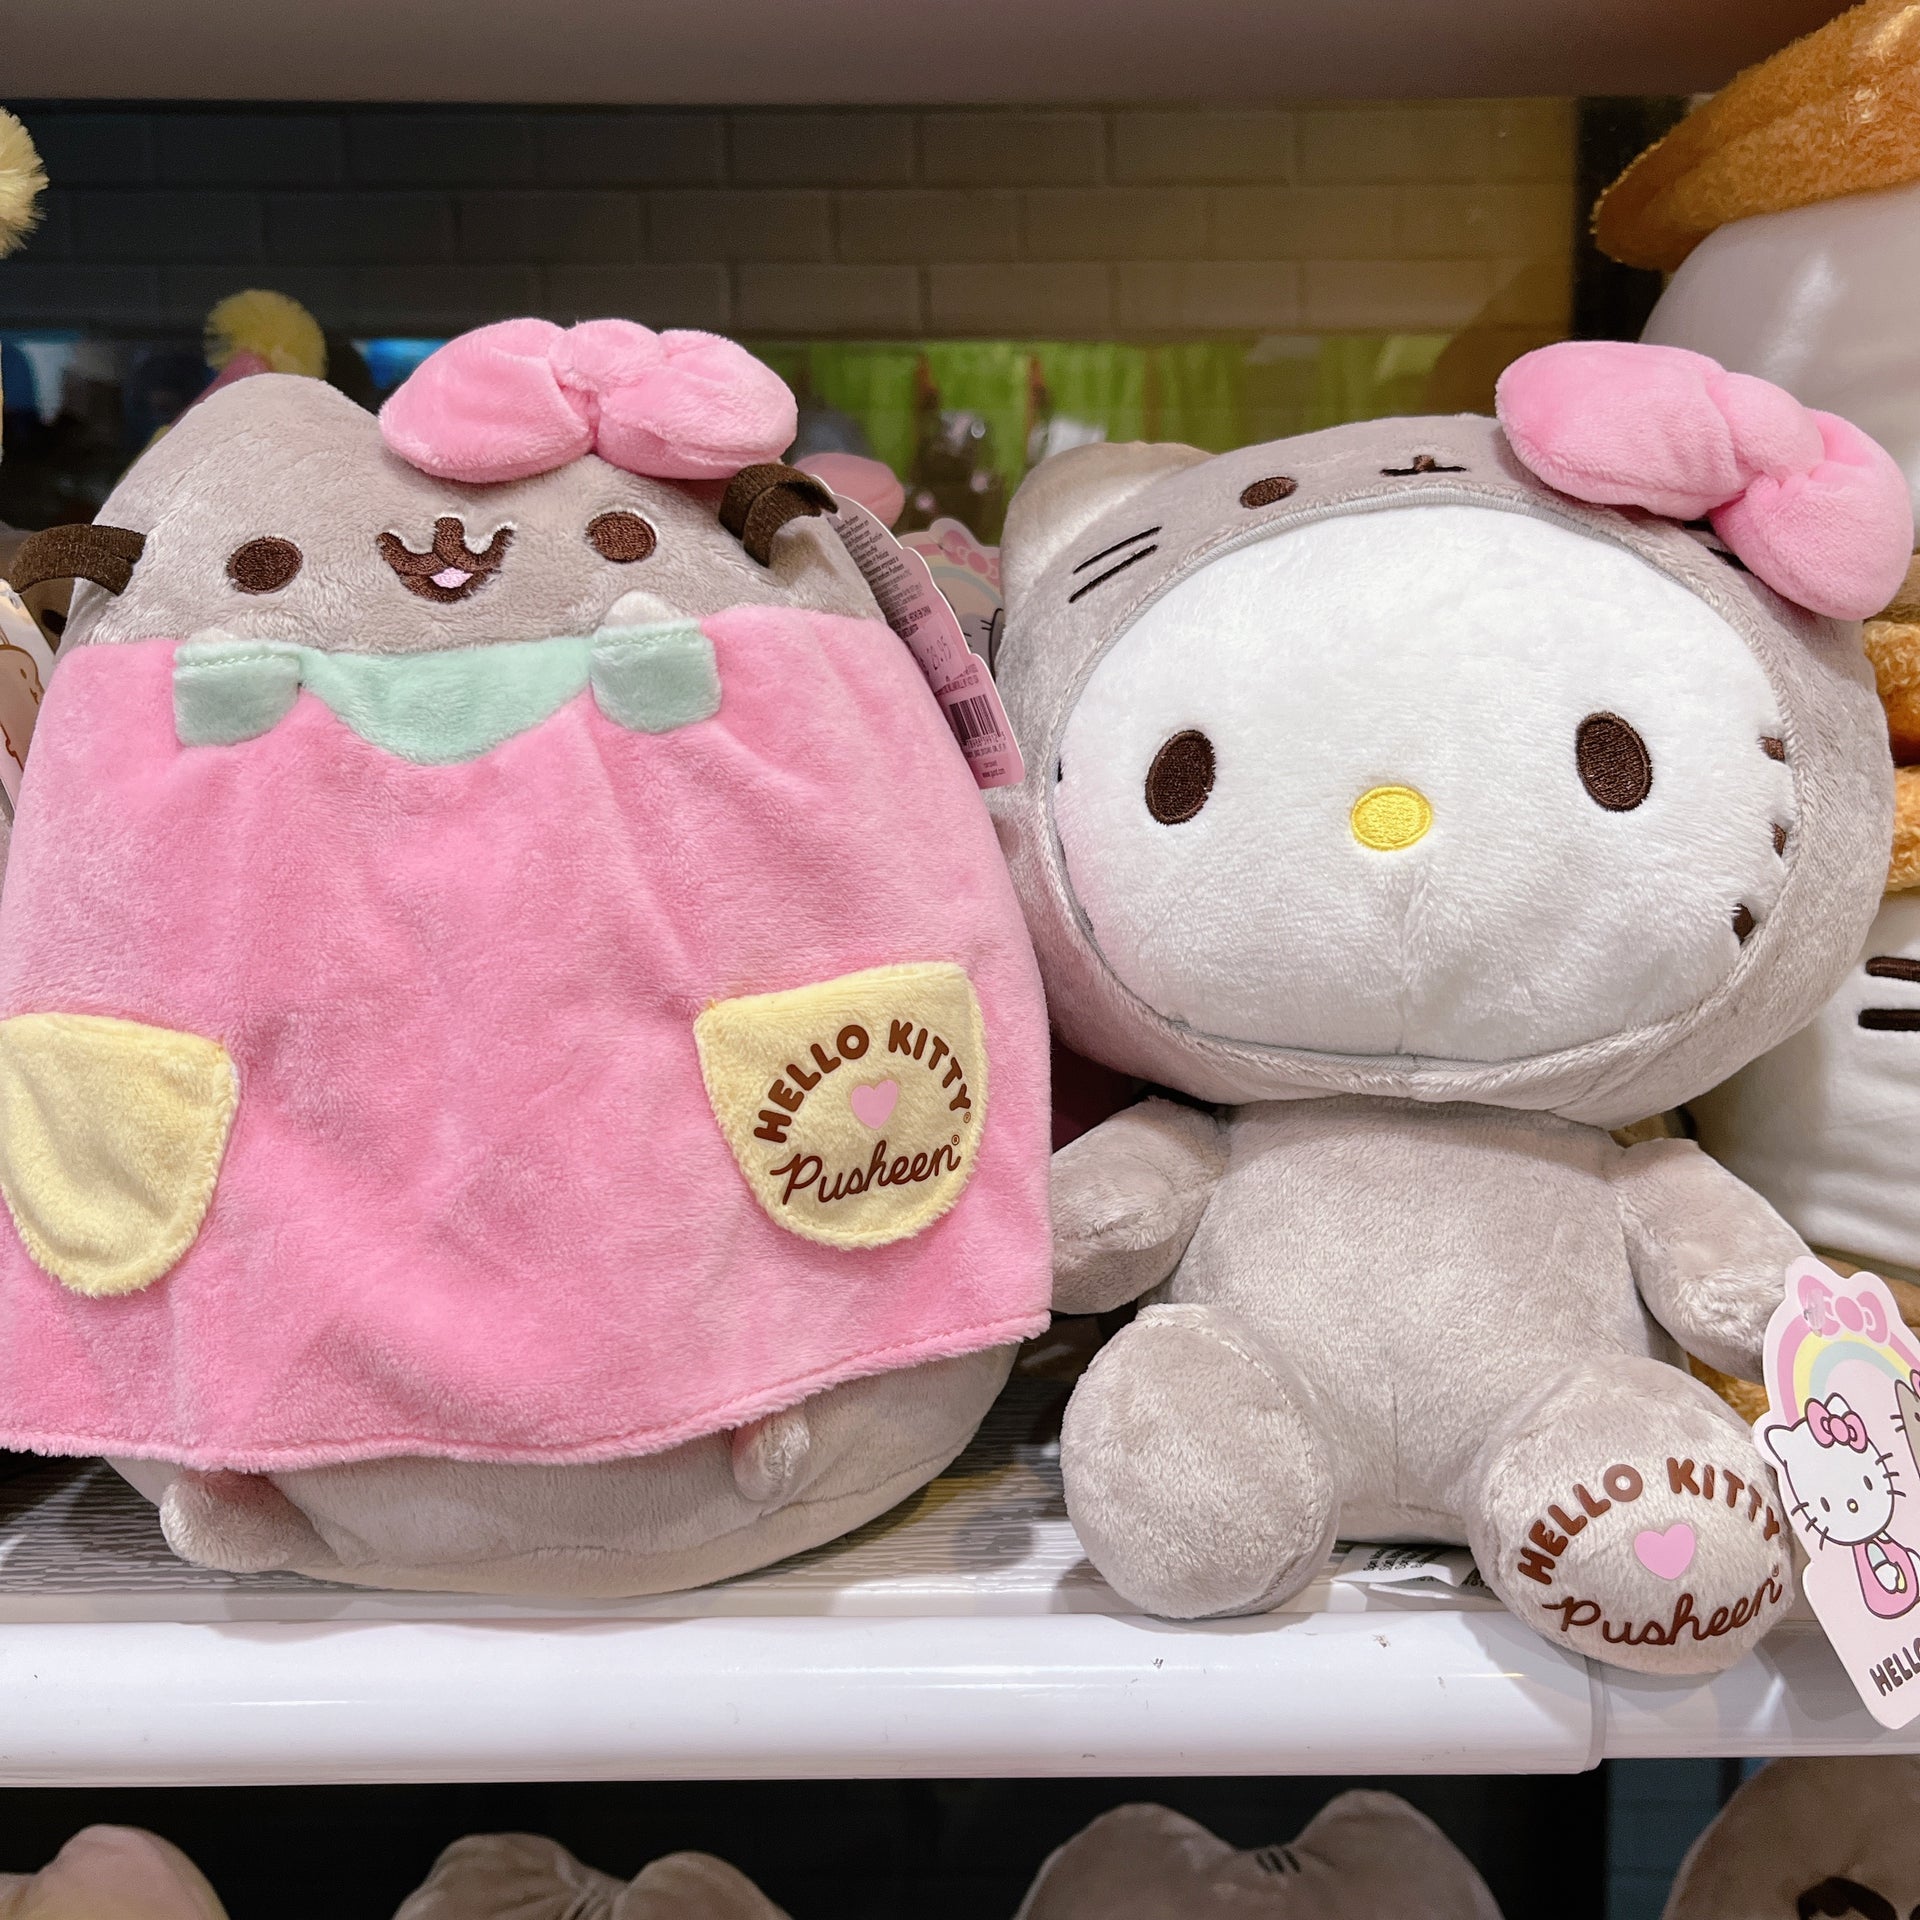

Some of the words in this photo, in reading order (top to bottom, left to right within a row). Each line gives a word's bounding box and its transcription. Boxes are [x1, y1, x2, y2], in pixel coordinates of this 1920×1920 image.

[753, 1024, 869, 1144] HELLO
[888, 1019, 971, 1111] KITTY
[770, 1139, 961, 1205] Pusheen
[1517, 1463, 1643, 1585] HELLO
[1666, 1457, 1780, 1541] KITTY
[1542, 1577, 1783, 1646] Pusheen
